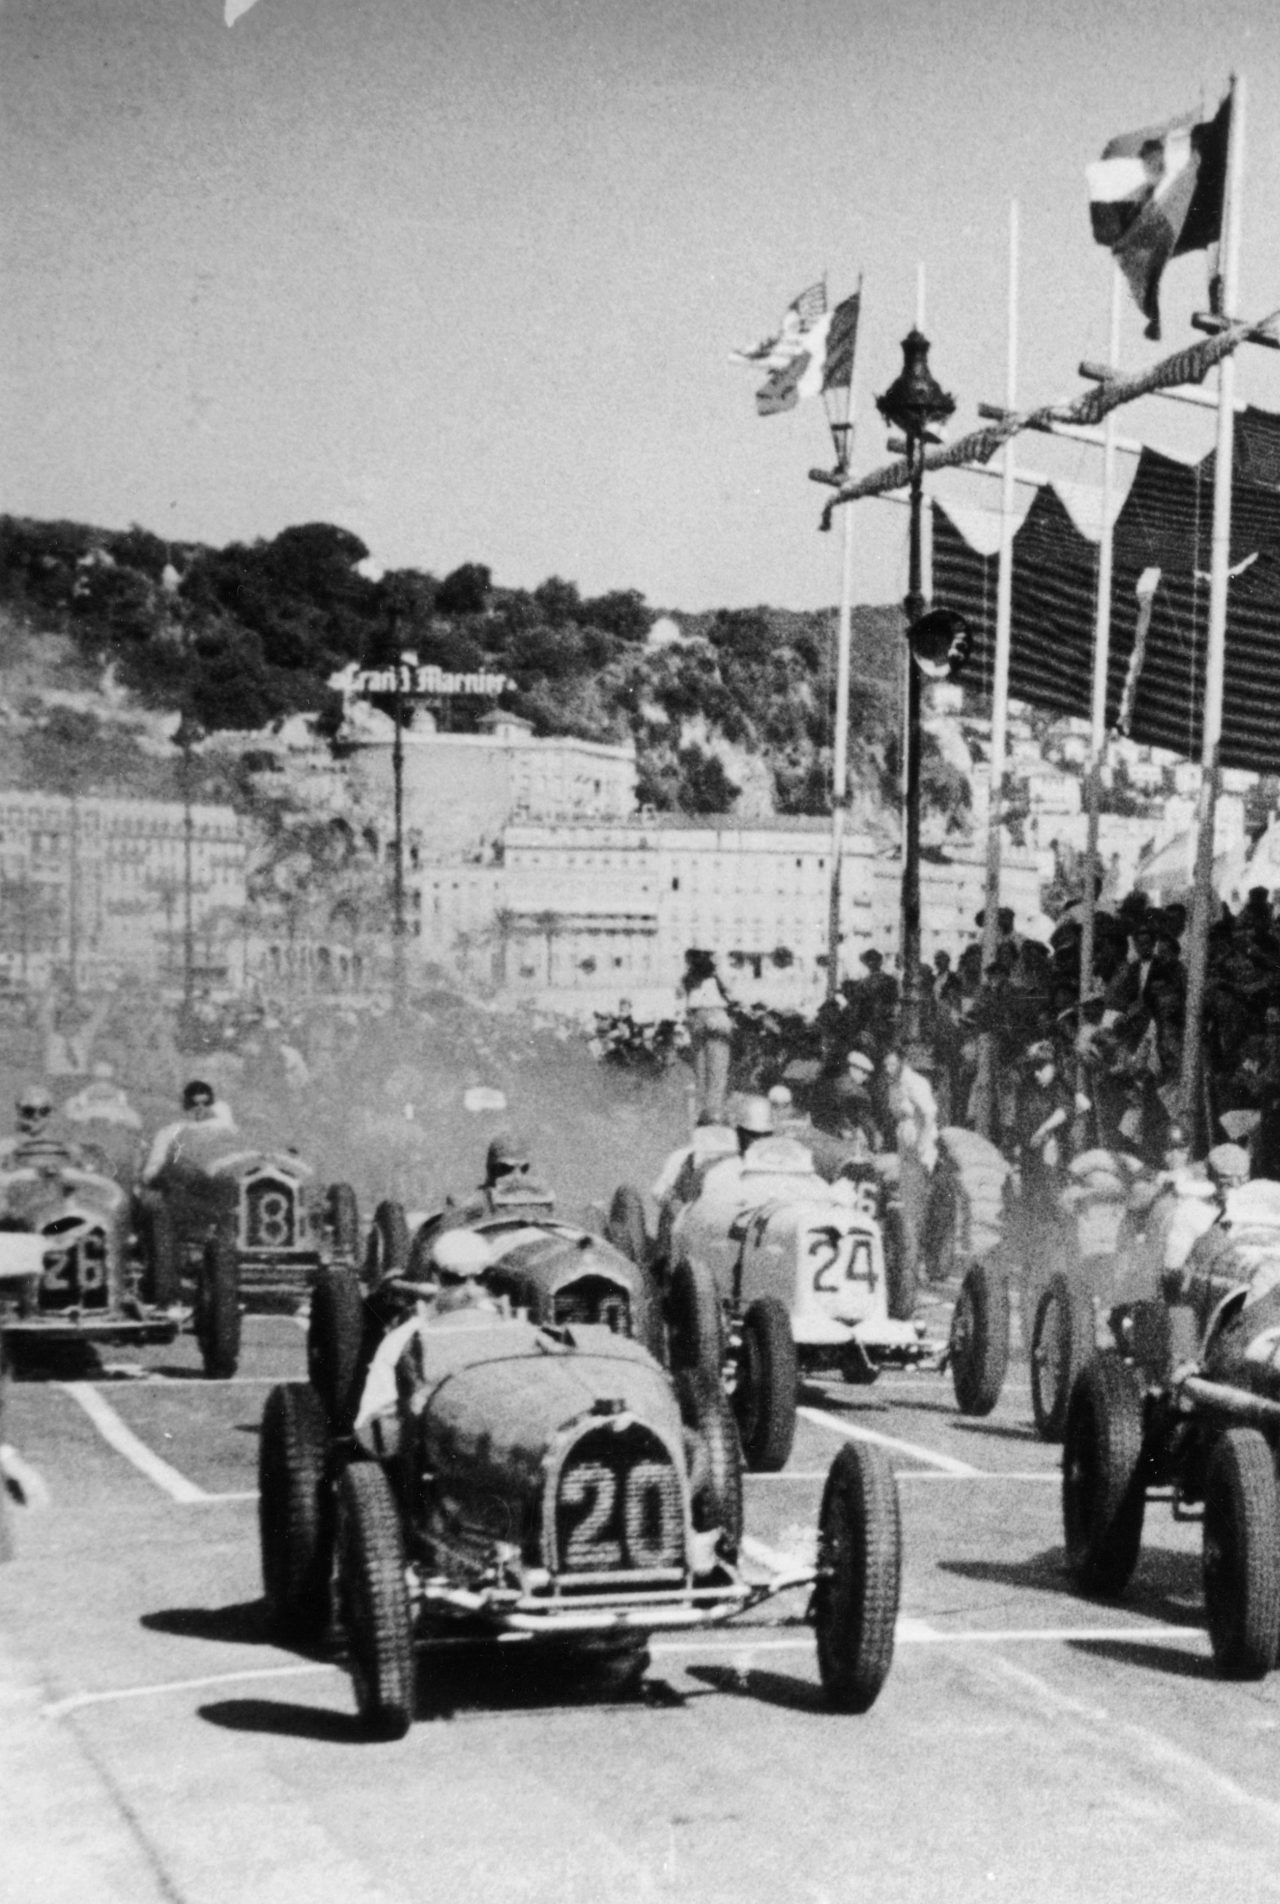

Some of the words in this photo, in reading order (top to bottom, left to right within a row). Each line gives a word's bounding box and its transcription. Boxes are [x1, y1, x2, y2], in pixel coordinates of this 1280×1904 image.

[416, 664, 507, 693] Marnier
[259, 1193, 289, 1246] 8
[43, 1235, 106, 1290] 26
[807, 1239, 879, 1293] 24
[560, 1460, 684, 1570] 20
